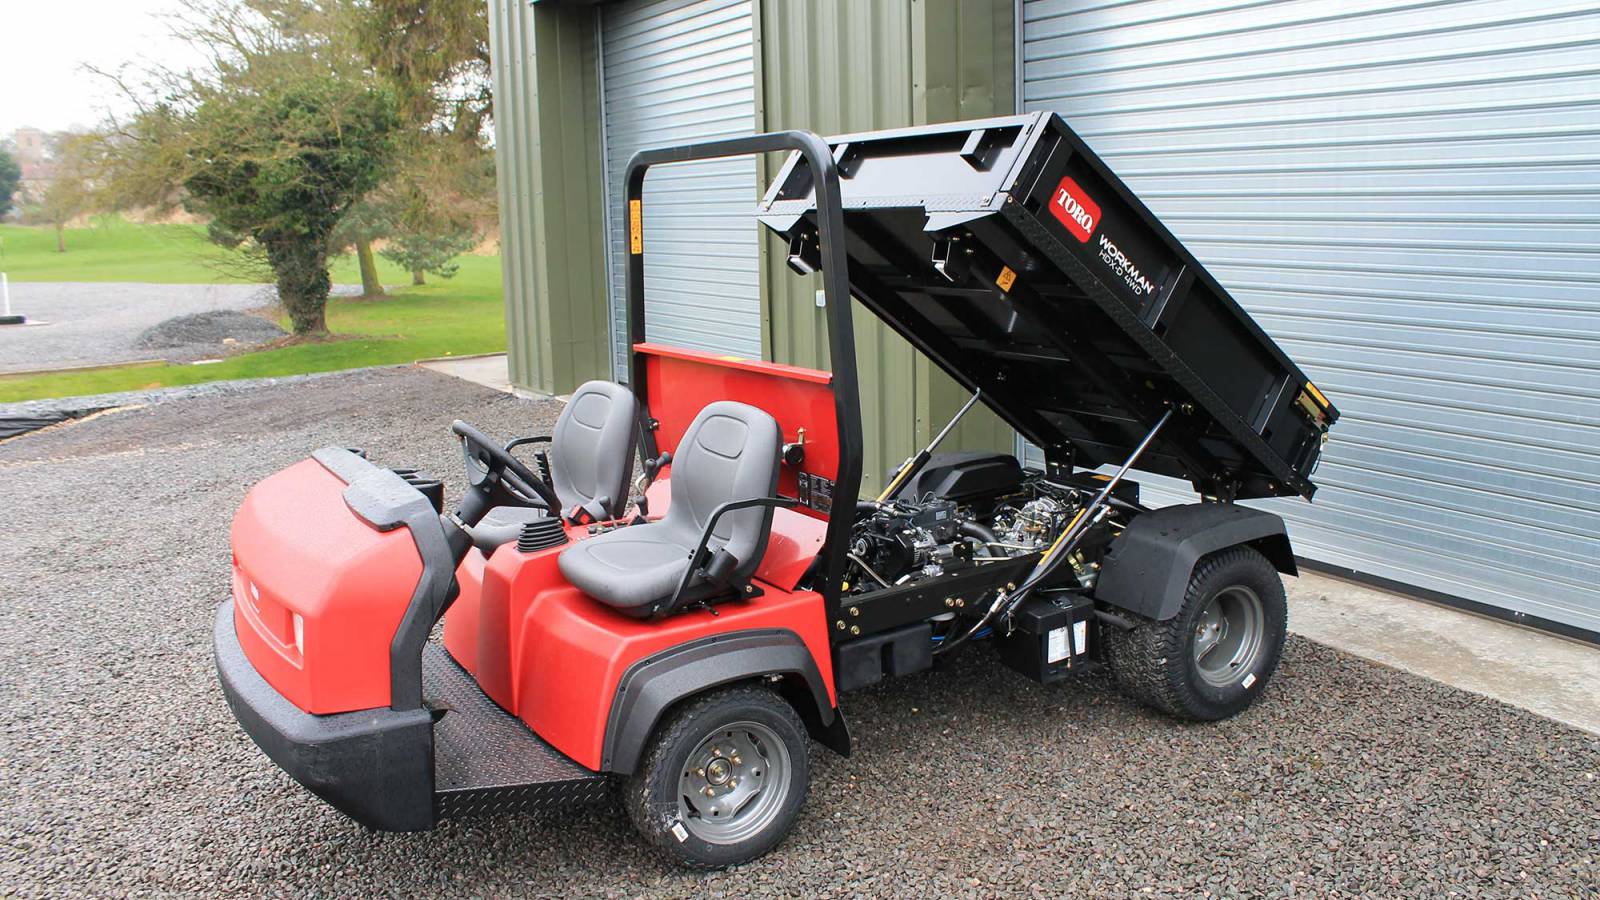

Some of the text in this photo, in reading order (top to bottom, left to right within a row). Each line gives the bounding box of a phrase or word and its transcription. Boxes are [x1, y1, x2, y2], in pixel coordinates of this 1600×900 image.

[1099, 233, 1154, 294] WORKMAN
[1099, 249, 1142, 295] HDX-D 4WD
